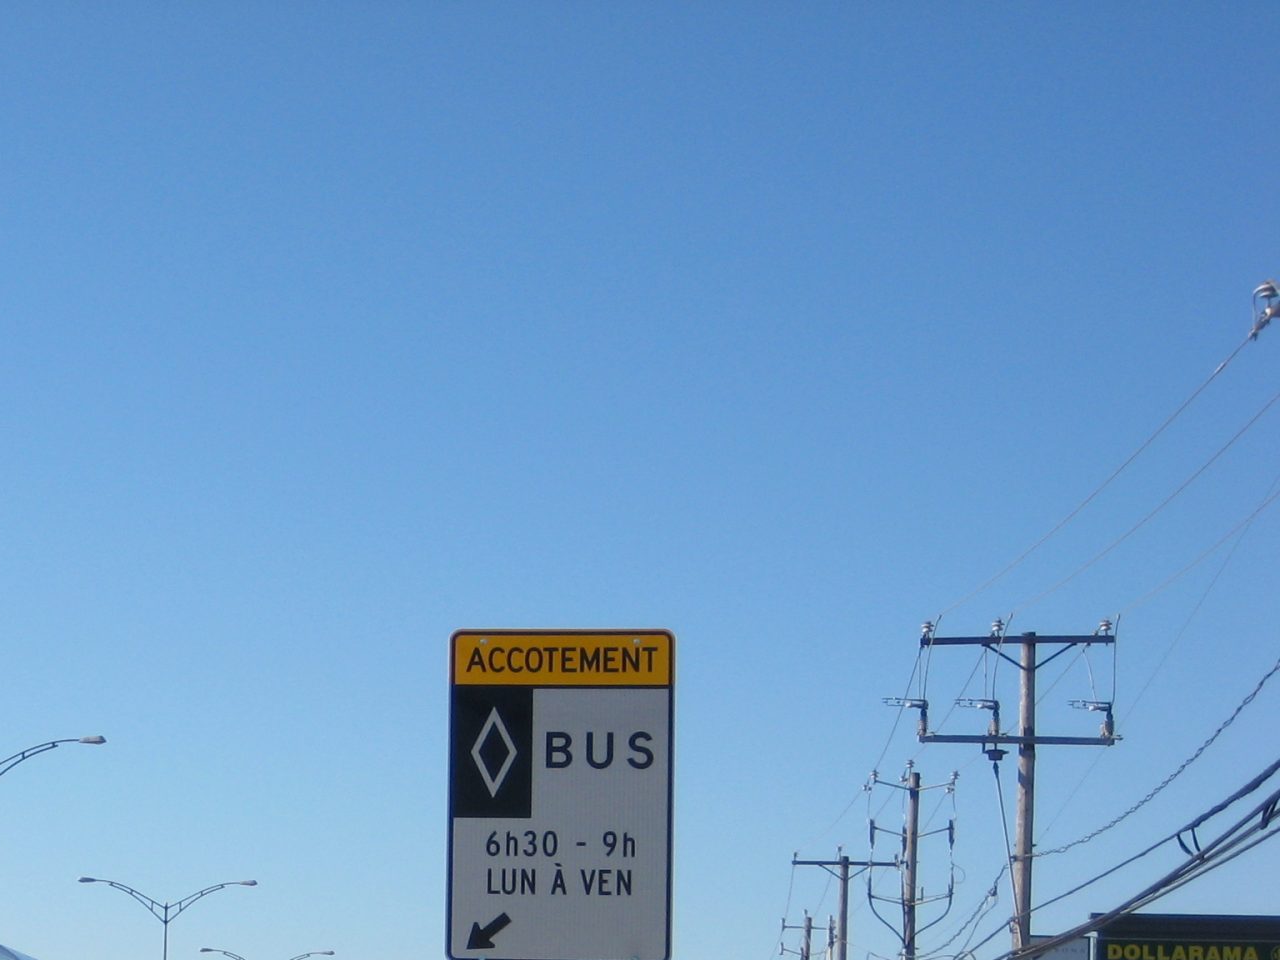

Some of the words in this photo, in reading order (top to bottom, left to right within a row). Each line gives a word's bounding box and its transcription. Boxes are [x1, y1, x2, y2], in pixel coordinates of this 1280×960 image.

[466, 646, 658, 673] ACCOTEMENT
[545, 731, 654, 769] BUS
[486, 830, 558, 857] 6h30
[603, 831, 636, 858] 9h
[487, 868, 536, 895] LUN
[551, 863, 567, 895] À
[580, 869, 632, 896] VEN
